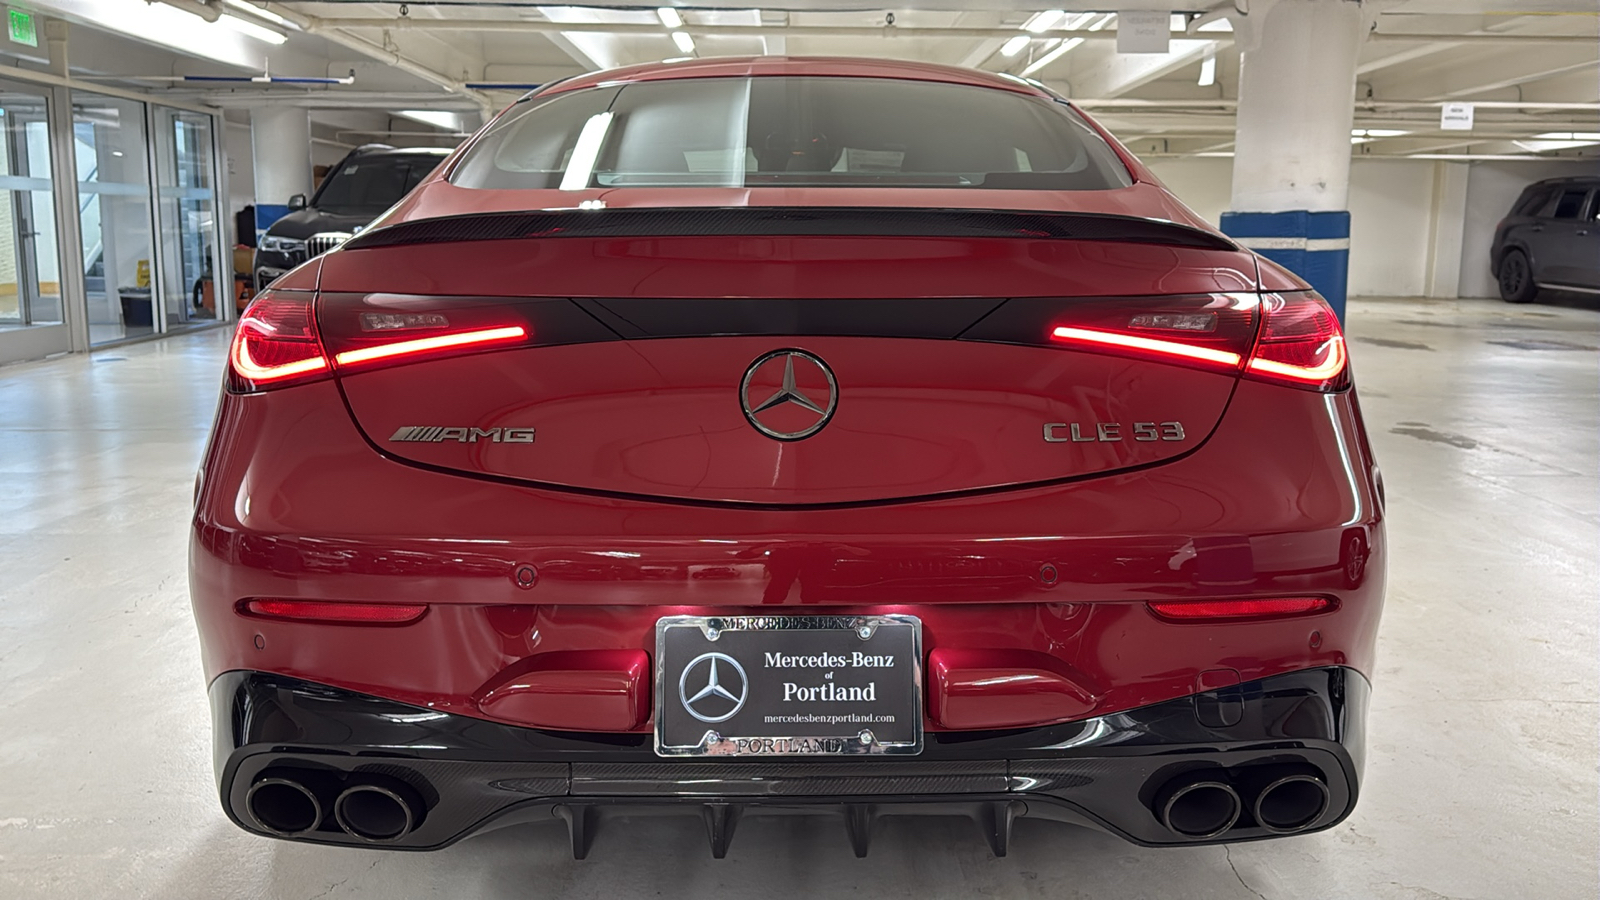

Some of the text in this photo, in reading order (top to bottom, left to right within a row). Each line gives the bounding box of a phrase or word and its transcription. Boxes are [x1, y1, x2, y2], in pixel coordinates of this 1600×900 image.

[432, 427, 535, 443] AMG
[1043, 421, 1186, 442] CLE 53
[721, 616, 857, 630] MERCEDES-BENZ
[764, 652, 894, 668] Mercedes-Benz
[824, 671, 834, 680] of
[782, 682, 876, 701] Portland
[764, 713, 895, 725] mercedesbenzportland.com
[737, 738, 844, 753] PORTLAND
